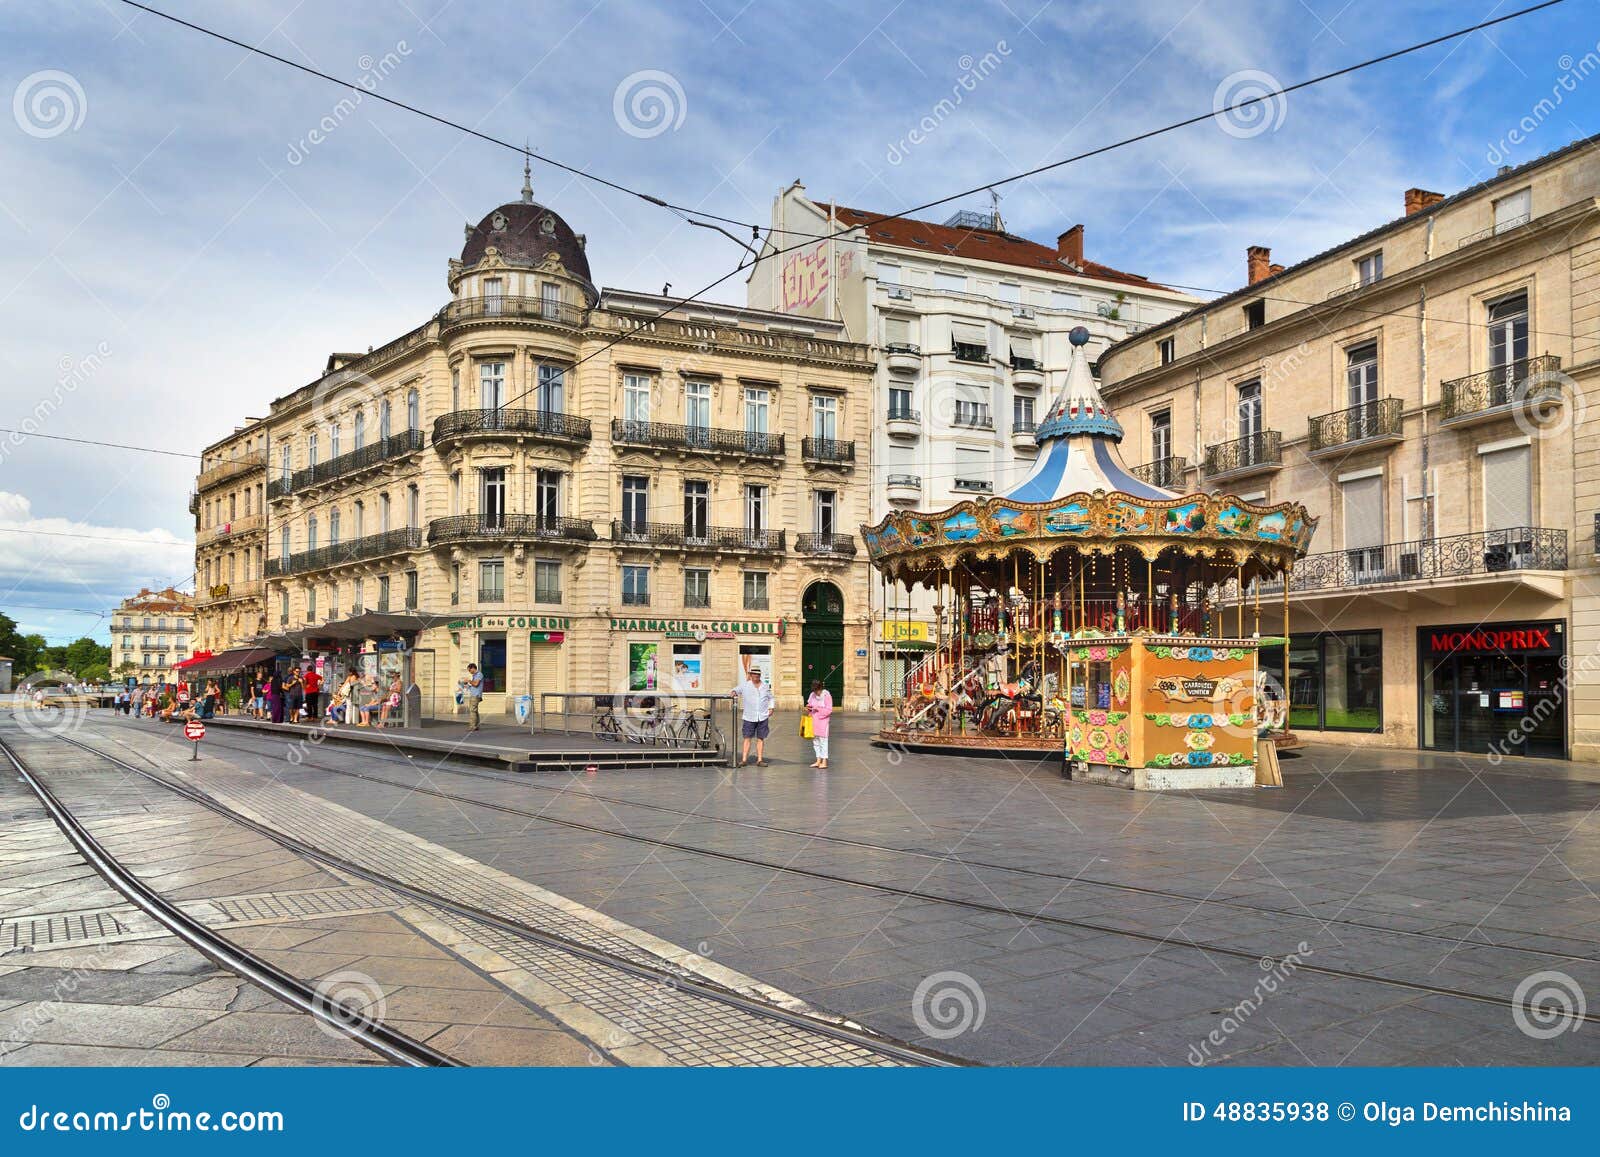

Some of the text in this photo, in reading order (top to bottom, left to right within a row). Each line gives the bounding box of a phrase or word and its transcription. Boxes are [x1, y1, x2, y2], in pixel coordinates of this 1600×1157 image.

[610, 619, 688, 631] PHARMACIE
[711, 622, 774, 633] COMEDIE
[1431, 629, 1550, 651] MONOPRIX
